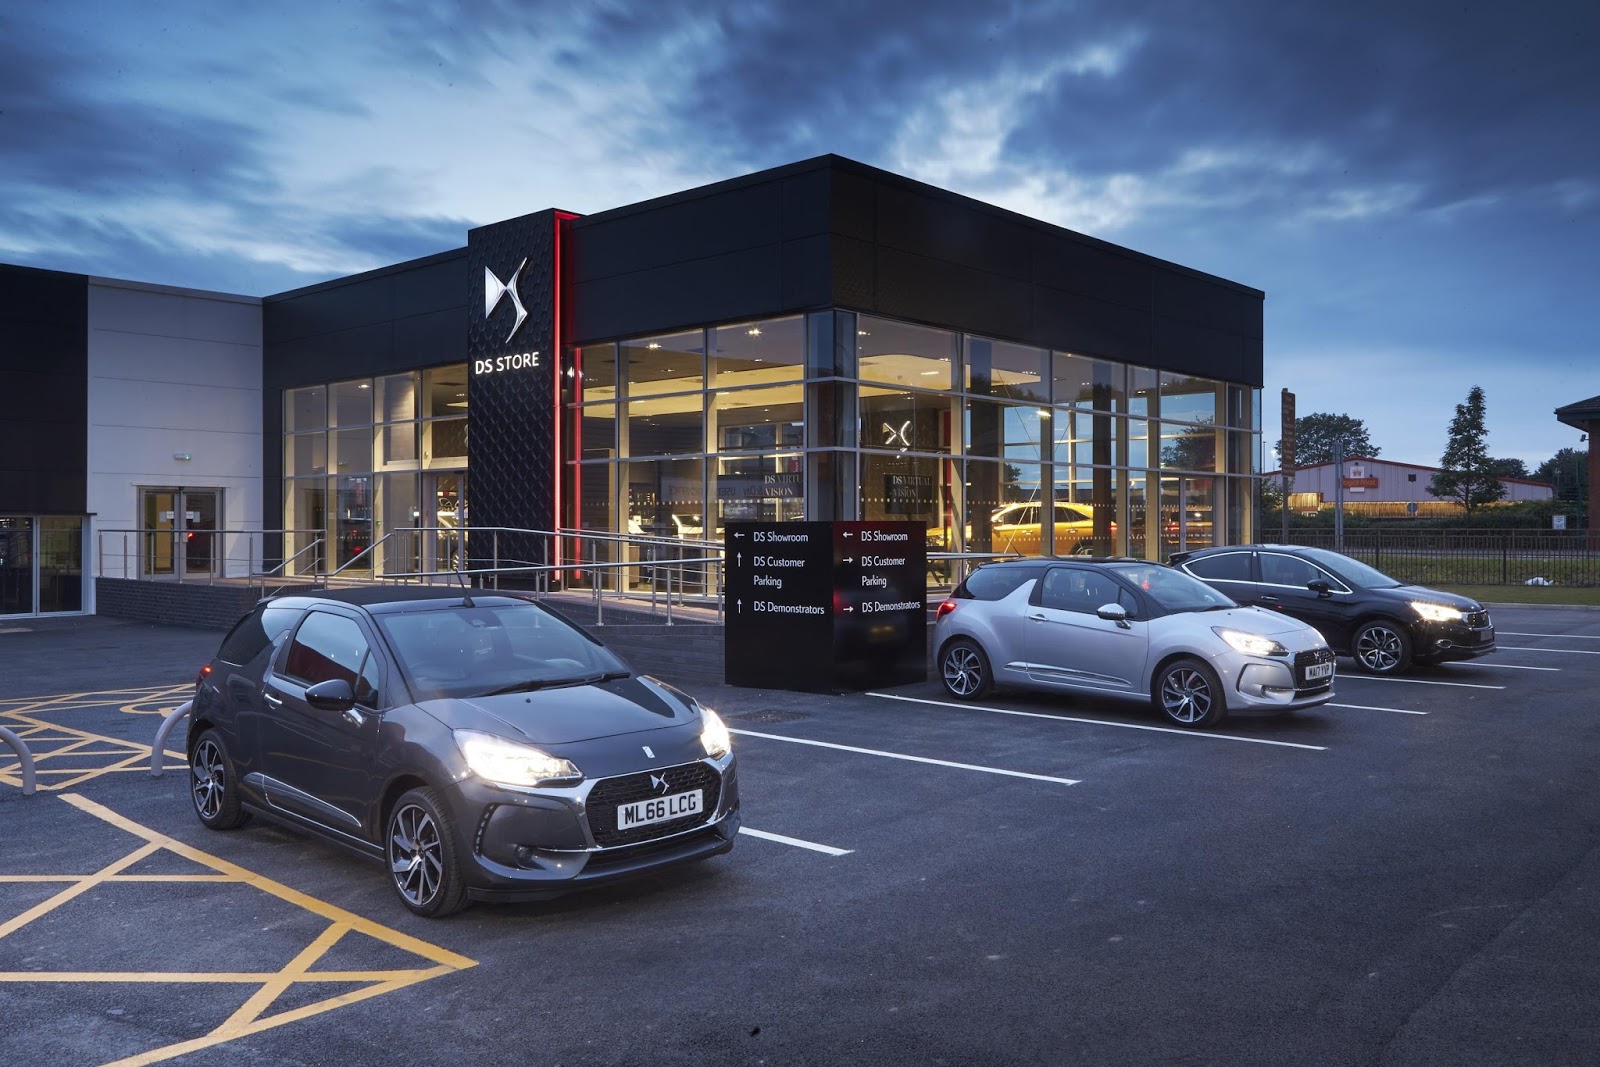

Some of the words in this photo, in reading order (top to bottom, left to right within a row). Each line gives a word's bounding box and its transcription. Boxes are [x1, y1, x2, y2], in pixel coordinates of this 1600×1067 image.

[475, 359, 493, 375] DS
[496, 352, 539, 372] STORE
[764, 475, 776, 484] DS
[892, 475, 902, 485] DS
[903, 476, 931, 486] VIRTUAL
[765, 487, 793, 496] VISION
[892, 488, 916, 497] VISION
[753, 531, 766, 542] DS
[767, 531, 809, 542] Showroom
[861, 531, 872, 541] DS
[873, 530, 908, 541] Showroom
[753, 556, 766, 567] DS
[767, 556, 805, 567] Customer
[861, 556, 872, 566] DS
[873, 556, 906, 566] Customer
[753, 575, 782, 589] Parking
[861, 576, 887, 588] Parking
[753, 601, 766, 612] DS
[767, 602, 825, 615] Demonstrators
[862, 602, 873, 613] DS
[874, 600, 921, 612] Demonstrators
[624, 800, 665, 825] ML66
[669, 793, 696, 815] LCG
